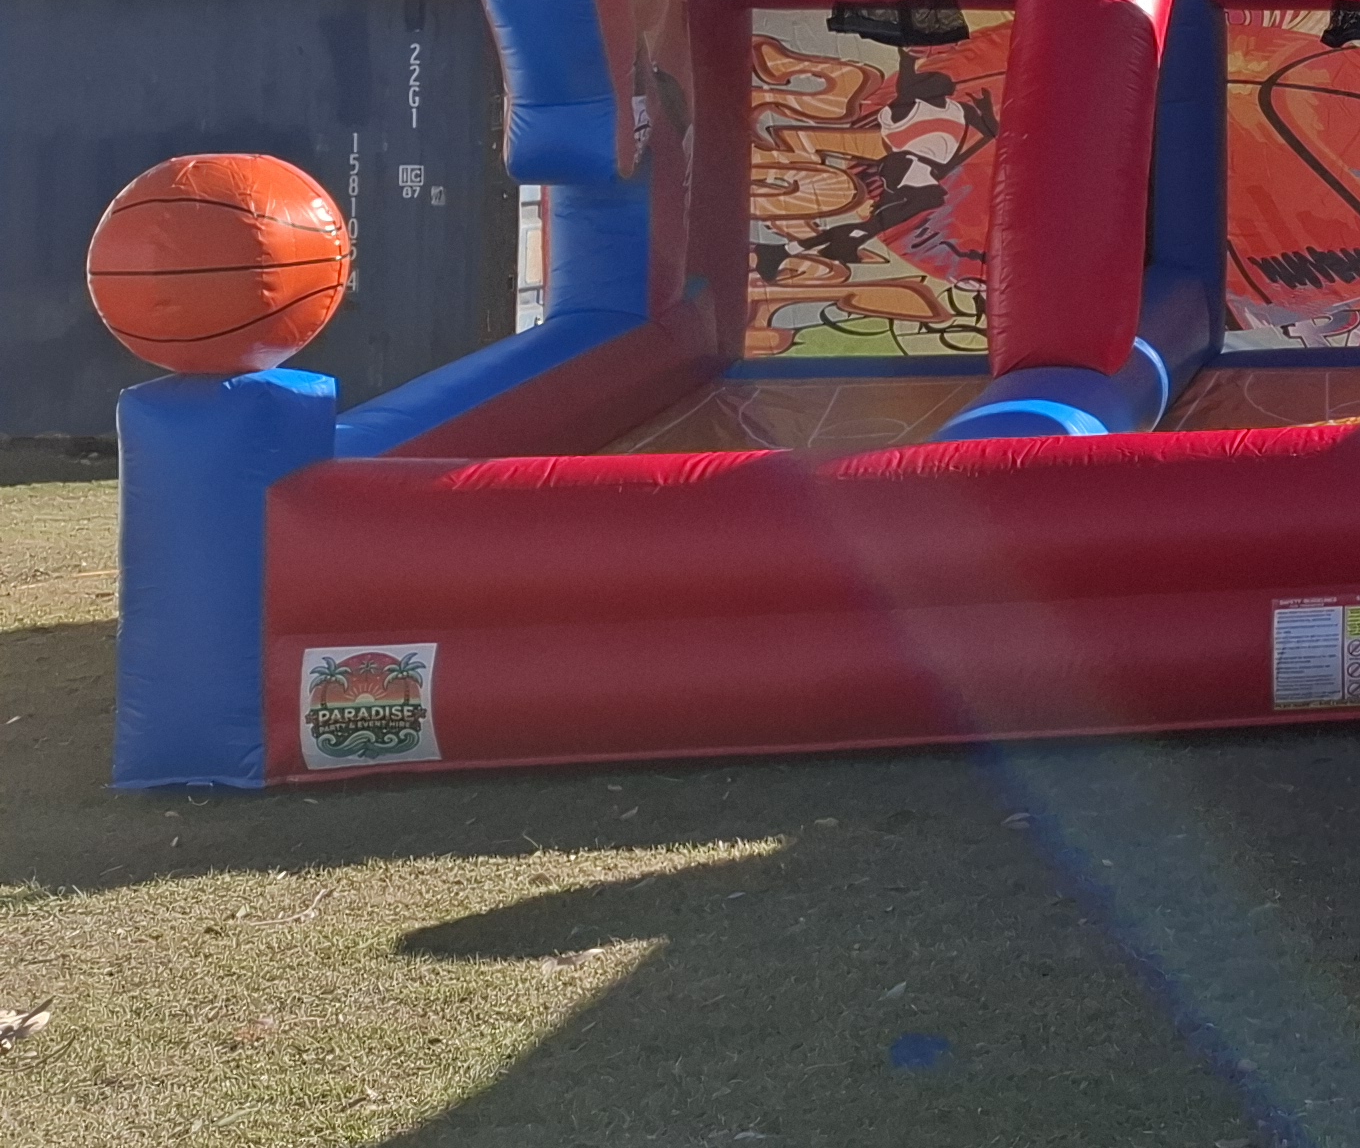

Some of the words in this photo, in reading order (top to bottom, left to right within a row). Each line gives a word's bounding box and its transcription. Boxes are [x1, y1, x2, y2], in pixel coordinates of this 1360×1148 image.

[408, 43, 421, 129] 22G1
[318, 705, 415, 725] PARADISE
[319, 723, 347, 733] PARTY
[357, 720, 386, 728] EVENT
[389, 720, 410, 728] HIRE
